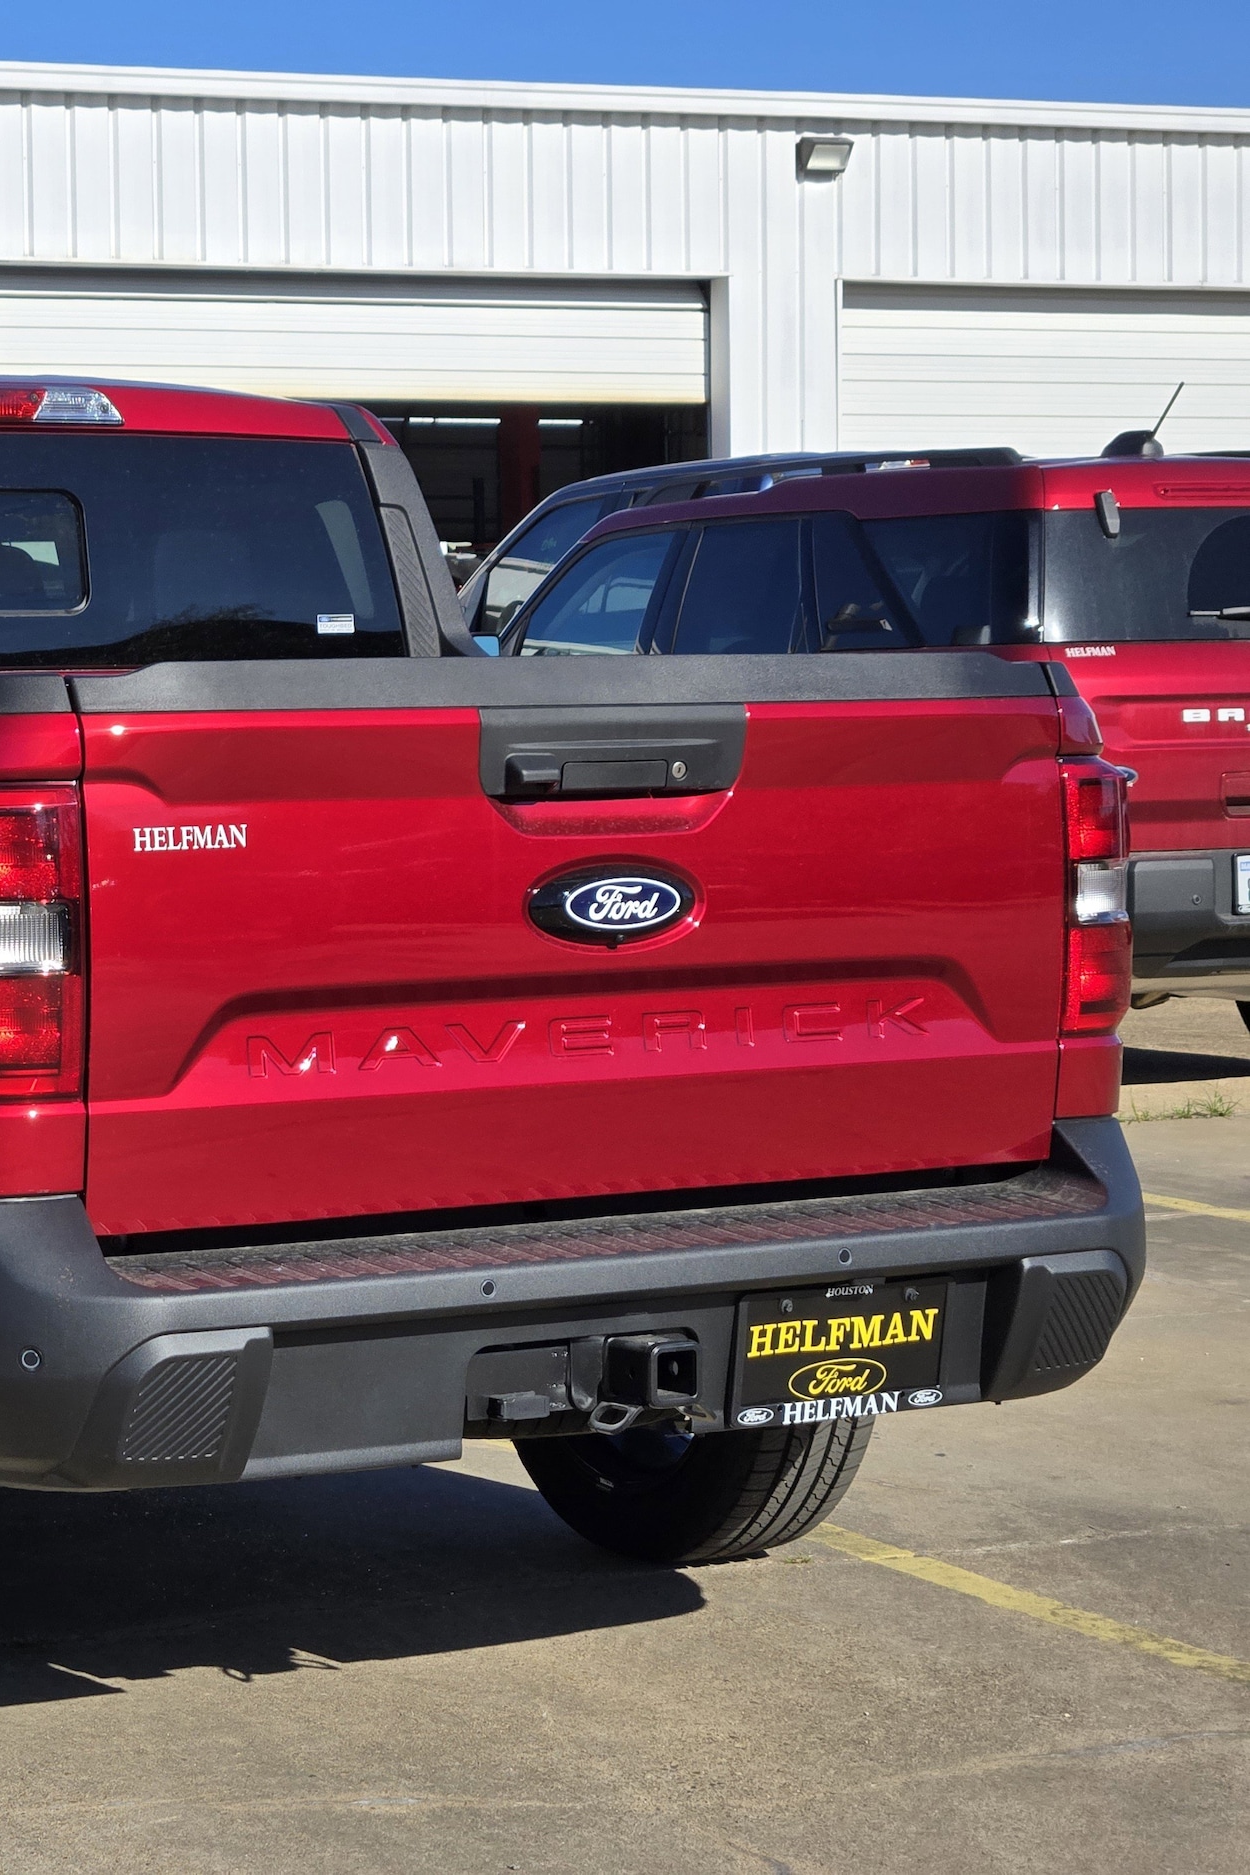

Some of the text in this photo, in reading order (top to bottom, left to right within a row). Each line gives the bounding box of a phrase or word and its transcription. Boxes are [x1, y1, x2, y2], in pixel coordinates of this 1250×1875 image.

[1064, 646, 1116, 658] HELFMAN
[1182, 708, 1246, 722] BR
[132, 824, 248, 852] HELFMAN
[588, 885, 660, 920] Ford
[246, 996, 930, 1079] MAVERICK
[825, 1284, 874, 1298] HOUSTON
[746, 1307, 940, 1358] HELFMAN
[808, 1362, 871, 1396] Ford
[782, 1391, 903, 1426] HELFMAN
